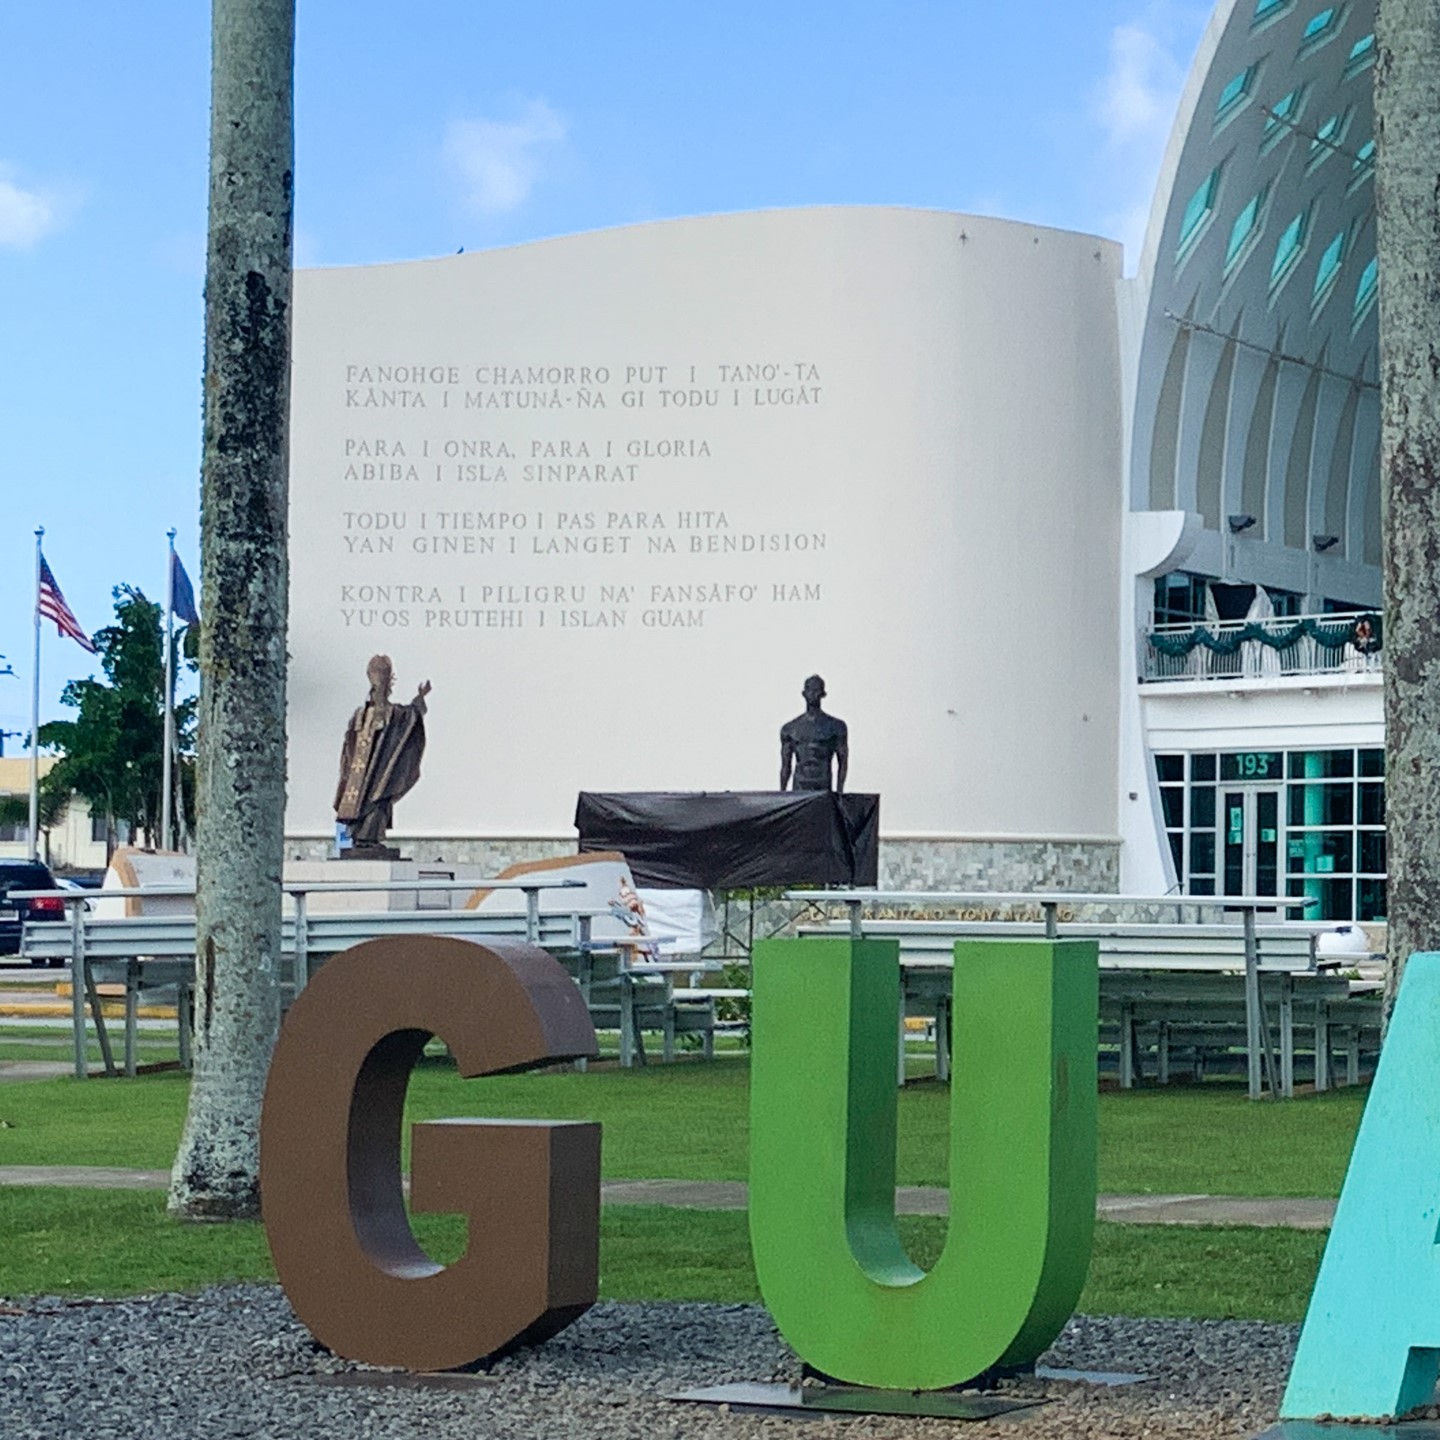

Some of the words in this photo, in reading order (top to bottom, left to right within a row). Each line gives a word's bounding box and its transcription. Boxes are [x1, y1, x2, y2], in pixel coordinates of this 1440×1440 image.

[346, 365, 460, 384] FANOHGE
[475, 365, 610, 384] CHAMORRO
[624, 366, 668, 384] PUT
[689, 365, 696, 384] I
[442, 390, 450, 408] I
[621, 391, 644, 407] GI
[658, 390, 719, 407] TODU
[732, 388, 740, 407] I
[345, 439, 406, 456] PARA
[421, 439, 430, 458] I
[443, 440, 516, 459] ONRA,
[531, 440, 591, 457] PARA
[604, 440, 613, 458] I
[626, 440, 711, 457] GLORIA
[344, 463, 419, 480] ABIBA
[435, 464, 443, 482] I
[457, 465, 508, 481] ISLA
[522, 464, 639, 482] SINPARAT
[342, 512, 406, 529] TODU
[419, 512, 427, 530] I
[436, 512, 527, 529] TIEMPO
[536, 511, 544, 530] I
[557, 512, 596, 529] PAS
[606, 512, 666, 529] PARA
[678, 511, 729, 529] HITA
[343, 536, 394, 553] YAN
[412, 536, 495, 553] GINEN
[508, 536, 517, 554] I
[532, 537, 631, 554] LANGET
[647, 537, 677, 553] NA
[689, 534, 826, 553] BENDISION
[341, 585, 442, 603] KONTRA
[458, 585, 466, 603] I
[481, 585, 586, 603] PILIGRU
[600, 586, 635, 603] NA'
[772, 584, 821, 601] HAM
[340, 609, 409, 626] YU'OS
[425, 610, 523, 628] PRUTEHI
[538, 610, 546, 628] I
[561, 610, 627, 627] ISLAN
[641, 610, 707, 627] GUAM
[1236, 754, 1268, 775] 193
